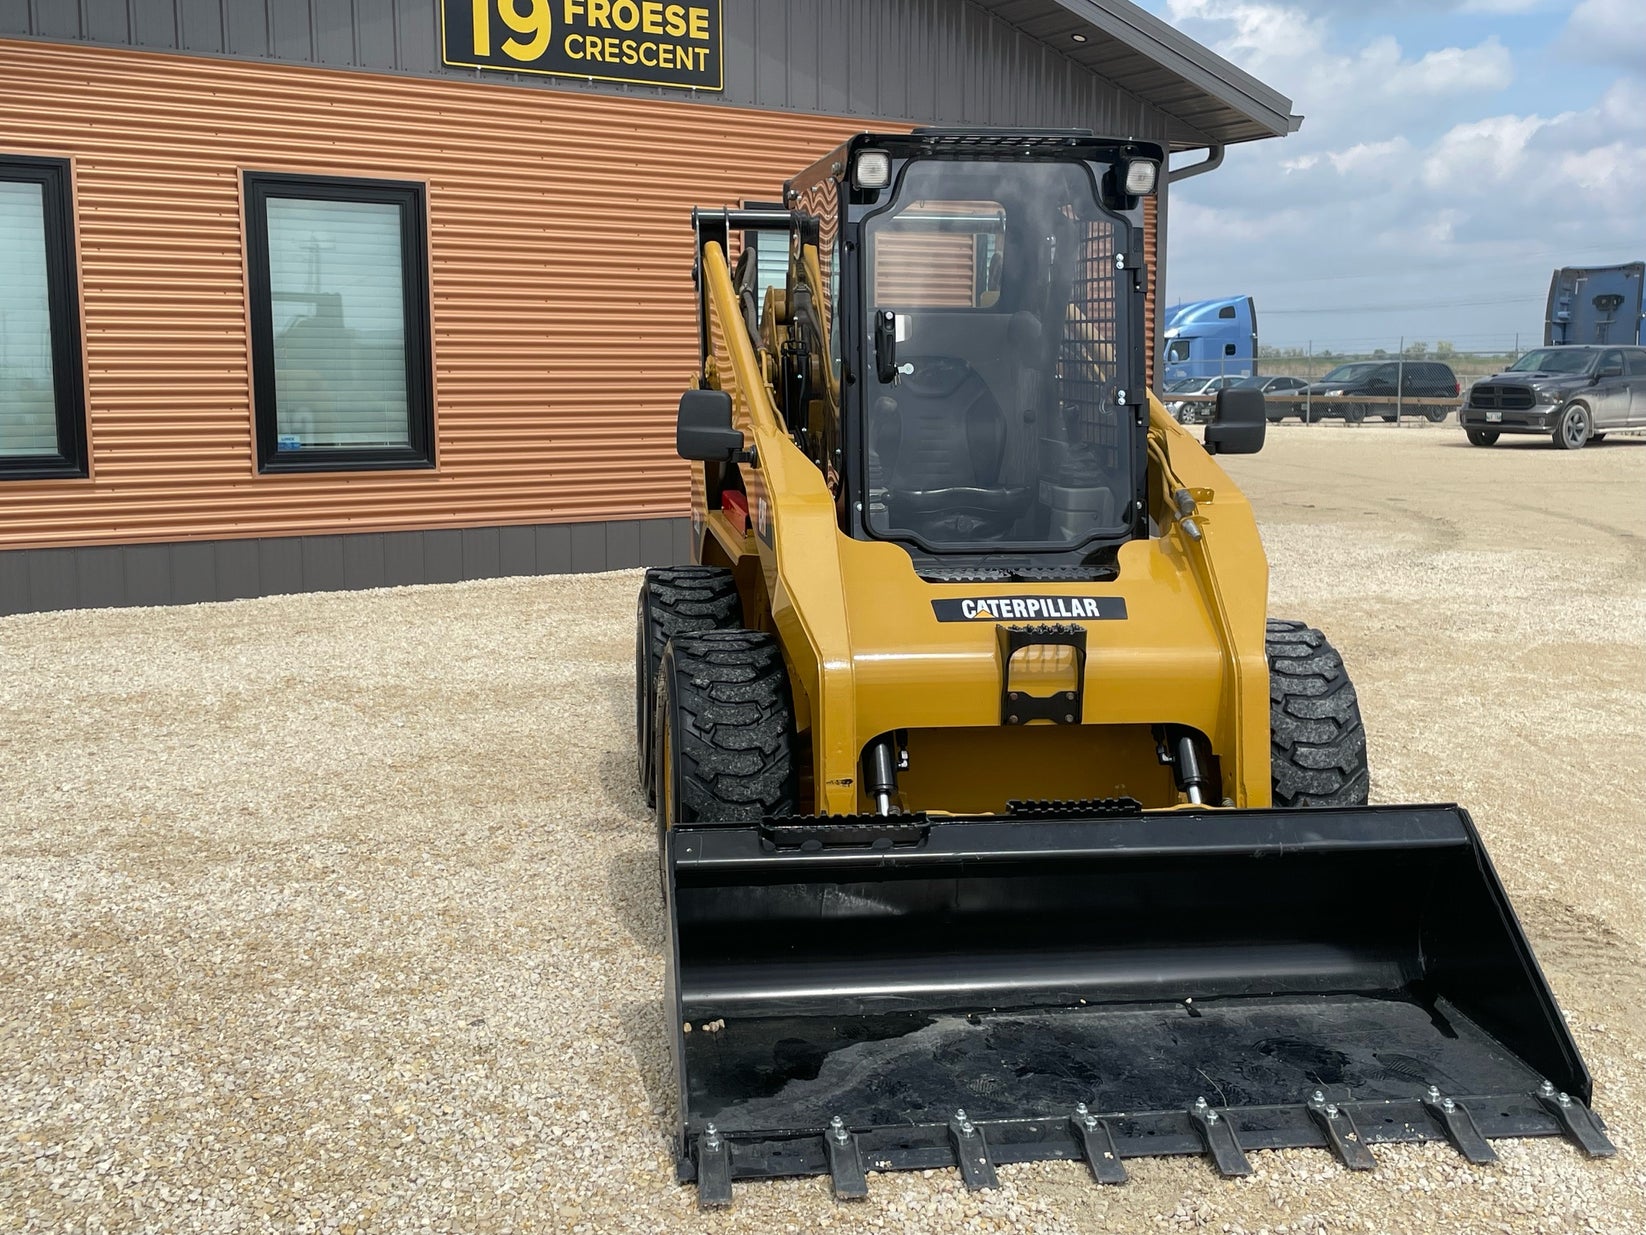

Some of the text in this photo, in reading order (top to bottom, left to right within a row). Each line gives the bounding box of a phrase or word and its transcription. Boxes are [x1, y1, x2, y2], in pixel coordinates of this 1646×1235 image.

[472, 0, 552, 61] 19
[564, 0, 710, 40] FROESE
[564, 33, 710, 72] CRESCENT
[961, 598, 1100, 619] CATERPILLAR
